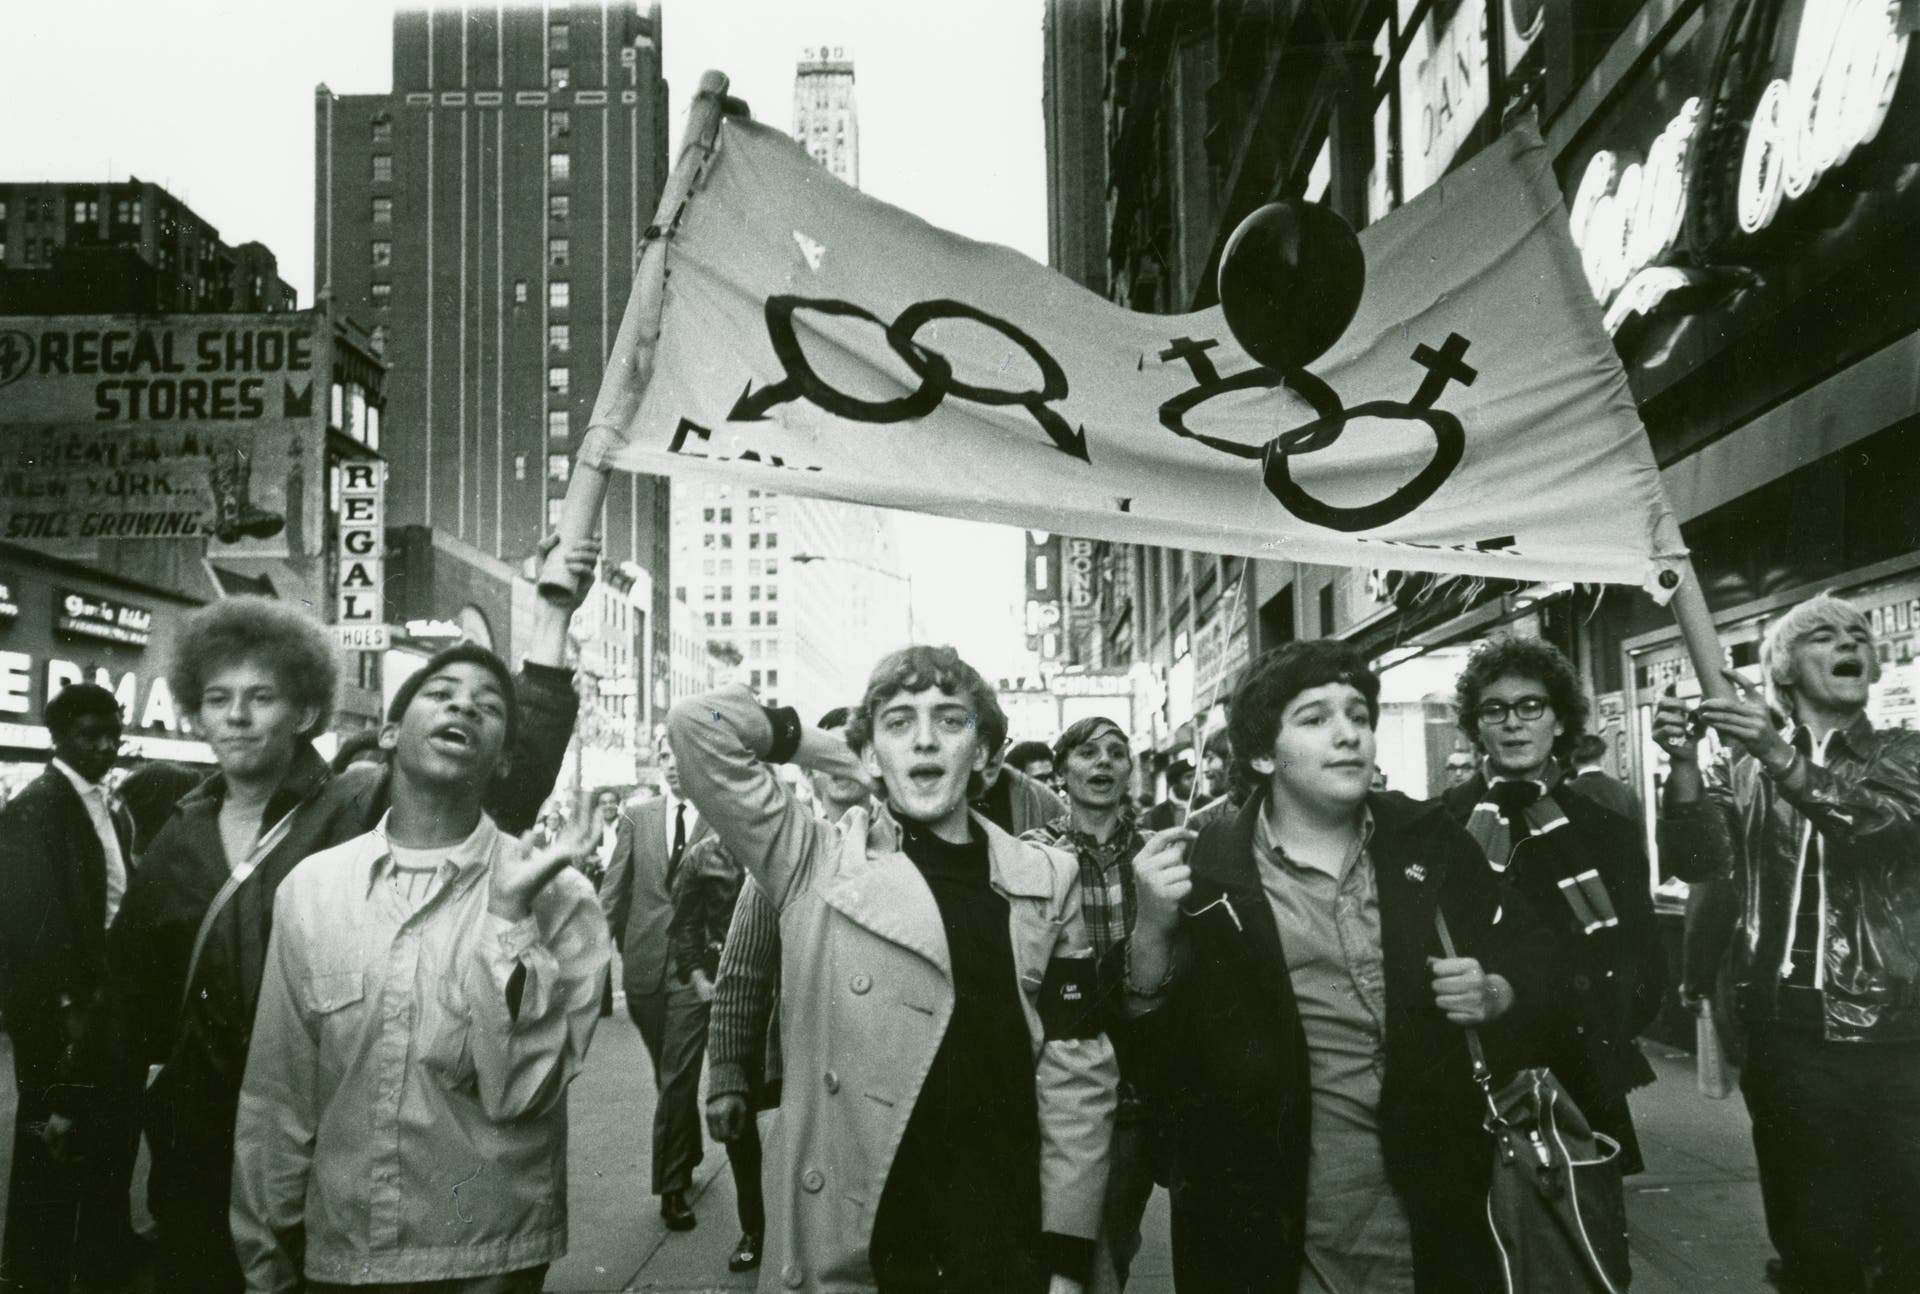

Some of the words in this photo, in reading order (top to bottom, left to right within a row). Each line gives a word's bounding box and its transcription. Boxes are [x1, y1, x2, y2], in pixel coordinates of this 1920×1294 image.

[39, 331, 186, 374] REGAL
[197, 331, 312, 372] SHOE
[95, 379, 264, 421] STORES
[5, 512, 68, 538] STILL
[343, 465, 376, 620] REGAL
[1071, 540, 1092, 606] BOND
